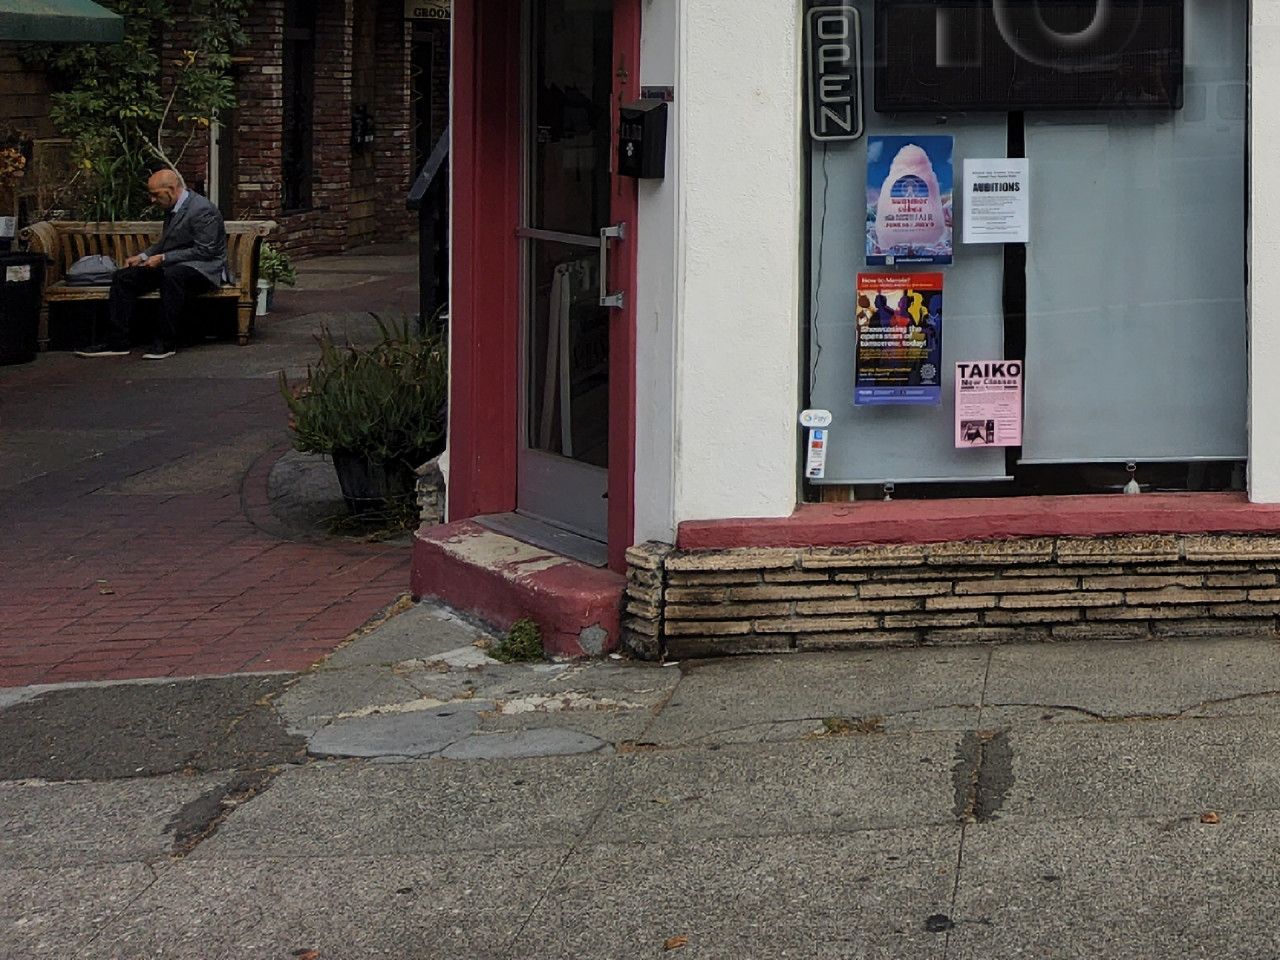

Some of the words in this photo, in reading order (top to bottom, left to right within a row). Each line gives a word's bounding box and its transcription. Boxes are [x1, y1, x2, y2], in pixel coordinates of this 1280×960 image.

[817, 15, 852, 133] OPEN
[973, 182, 1020, 192] AUDITIONS
[957, 363, 1021, 378] TAIKO
